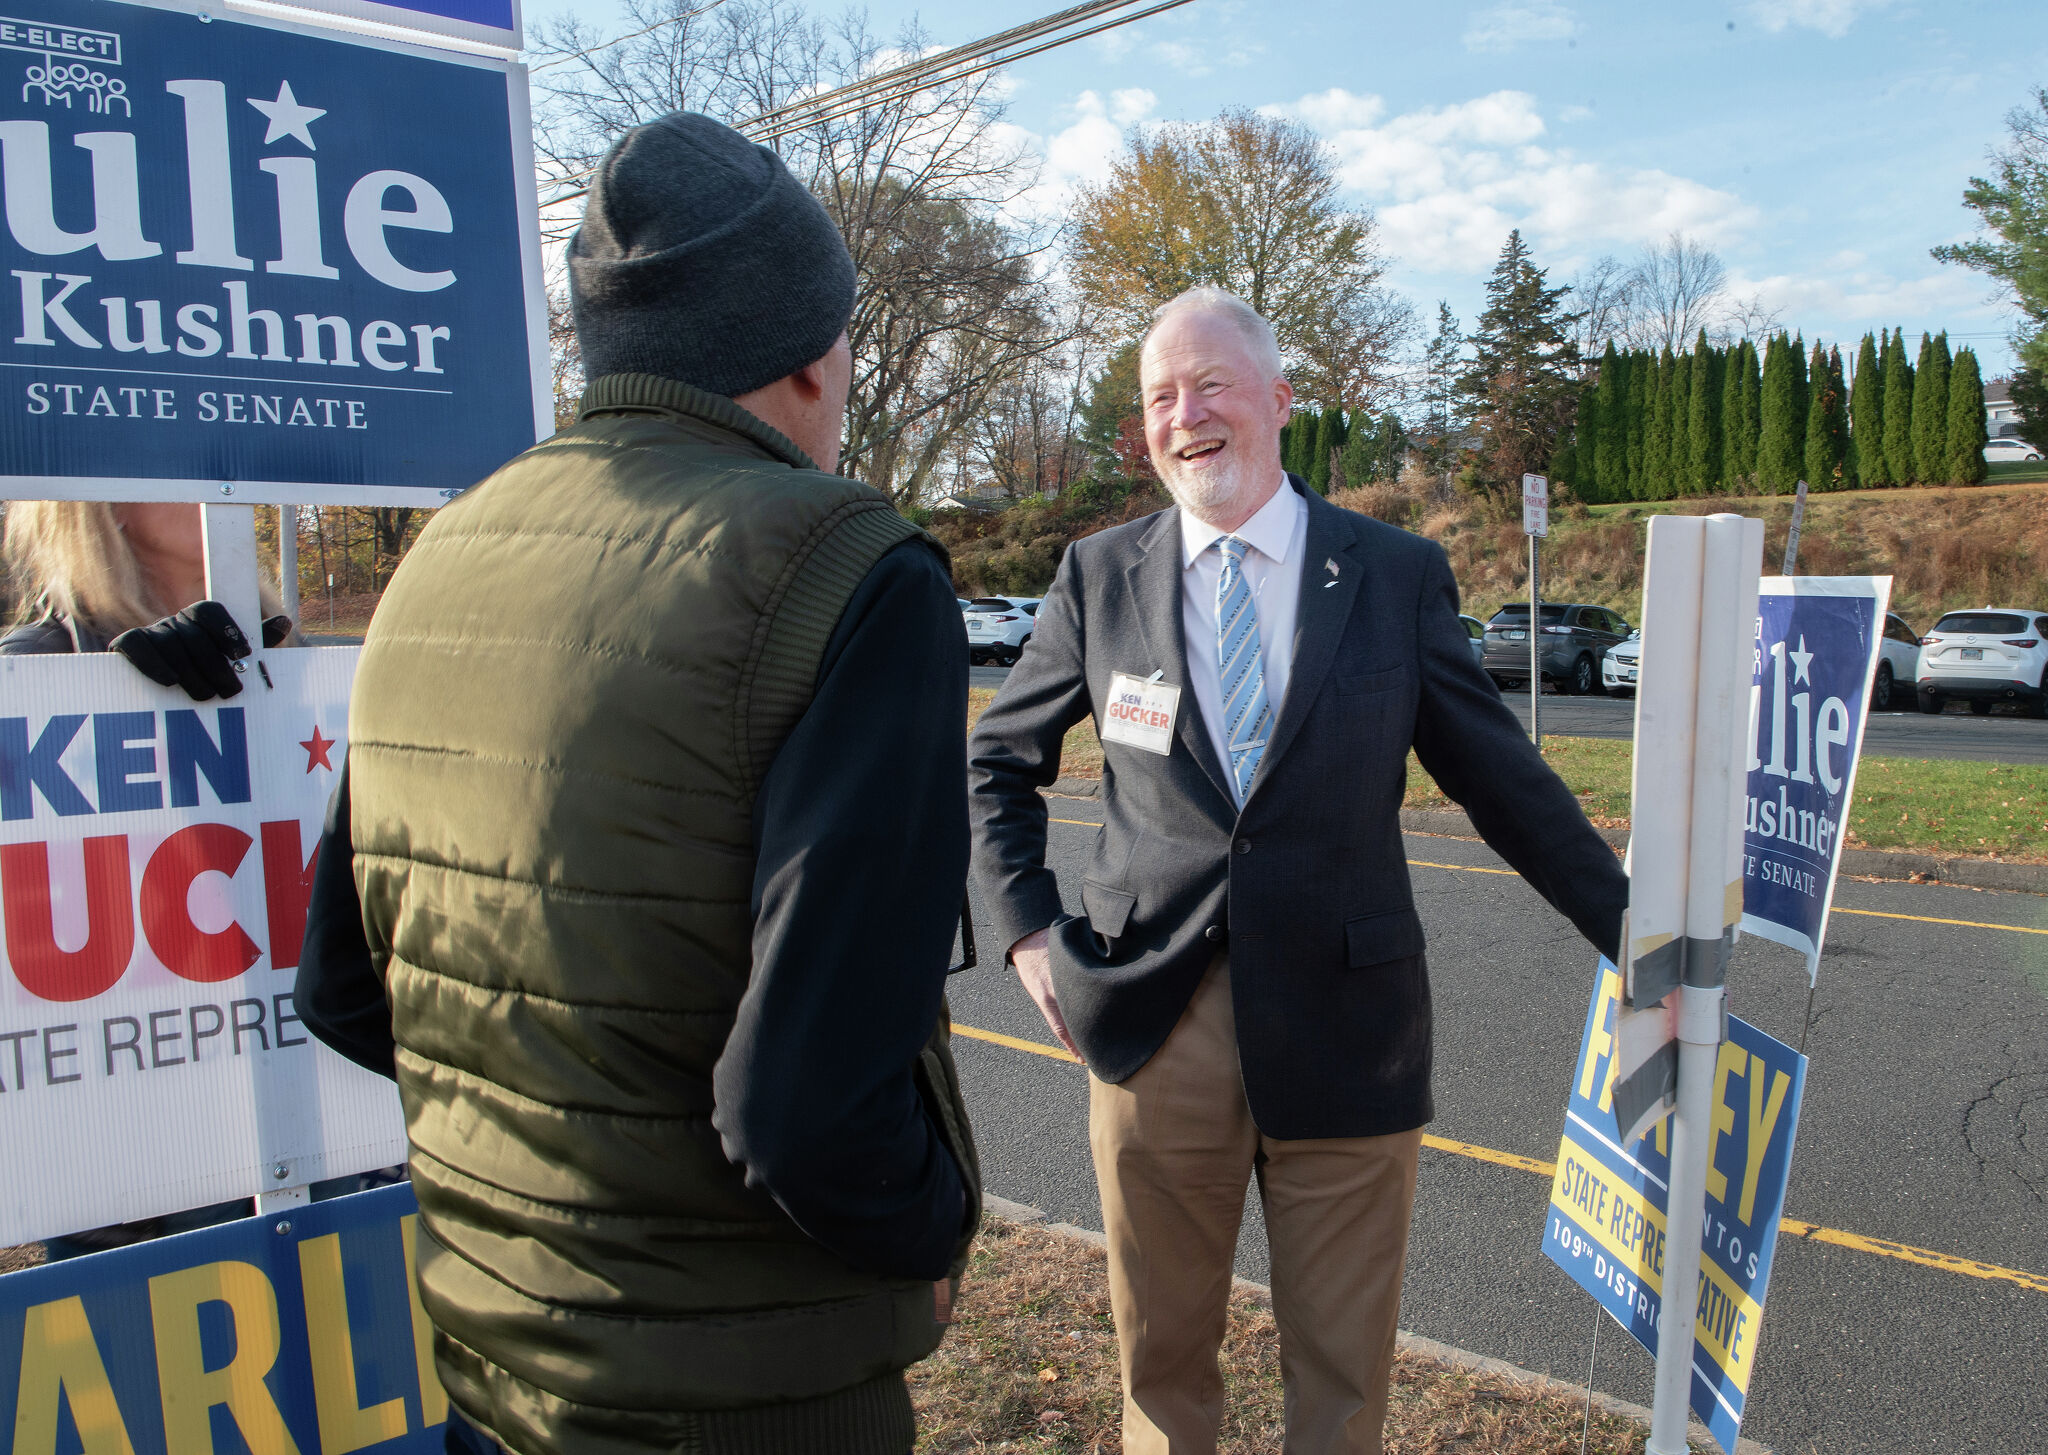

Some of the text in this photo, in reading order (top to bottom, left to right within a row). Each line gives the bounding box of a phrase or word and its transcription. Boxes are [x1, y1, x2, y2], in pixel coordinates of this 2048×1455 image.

[0, 24, 111, 55] E-ELECT
[0, 80, 457, 292] ulie
[11, 270, 450, 374] Kushner
[27, 383, 368, 429] STATE SENATE
[1109, 702, 1170, 729] GUCKER
[1120, 692, 1142, 706] KEN
[0, 707, 253, 821] KEN
[1761, 860, 1816, 898] SENATE
[0, 1023, 82, 1093] TE
[1562, 1157, 1609, 1226] STATE
